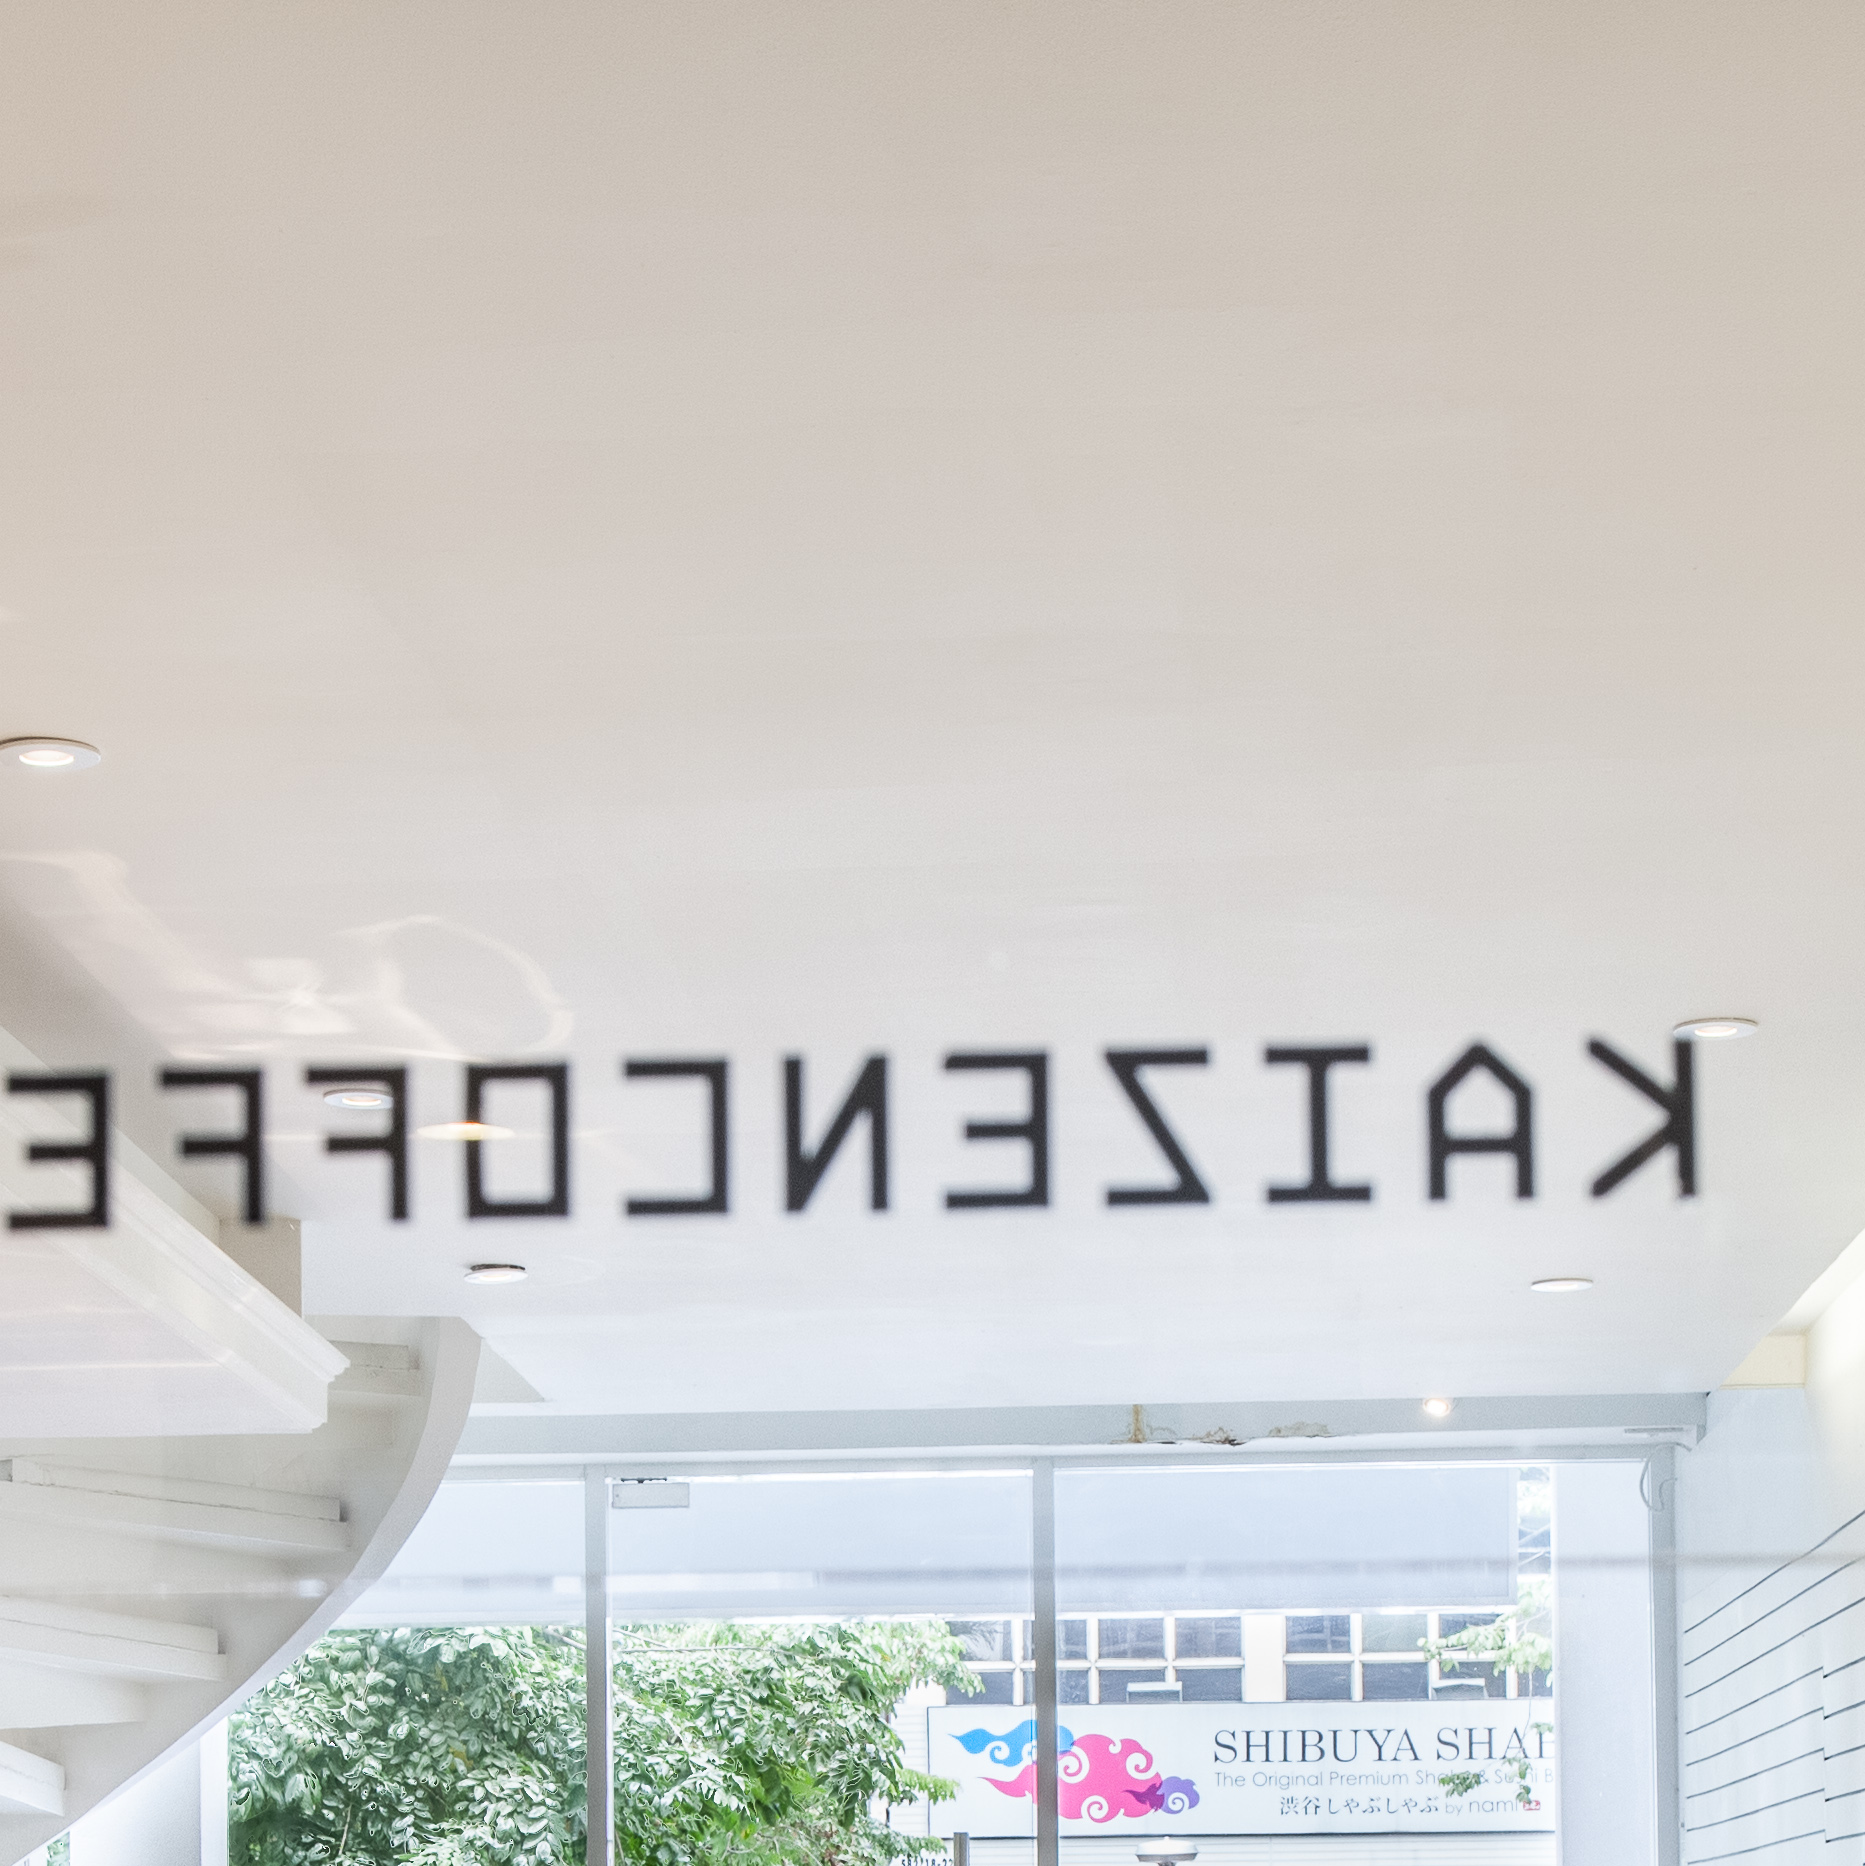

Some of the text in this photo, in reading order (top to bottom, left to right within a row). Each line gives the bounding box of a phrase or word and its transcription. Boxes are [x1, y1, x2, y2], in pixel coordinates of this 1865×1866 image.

[1214, 1728, 1422, 1763] SHIBUYA
[1215, 1772, 1246, 1787] The
[1252, 1771, 1323, 1791] Original
[1330, 1771, 1409, 1786] Premium
[1445, 1801, 1463, 1816] by
